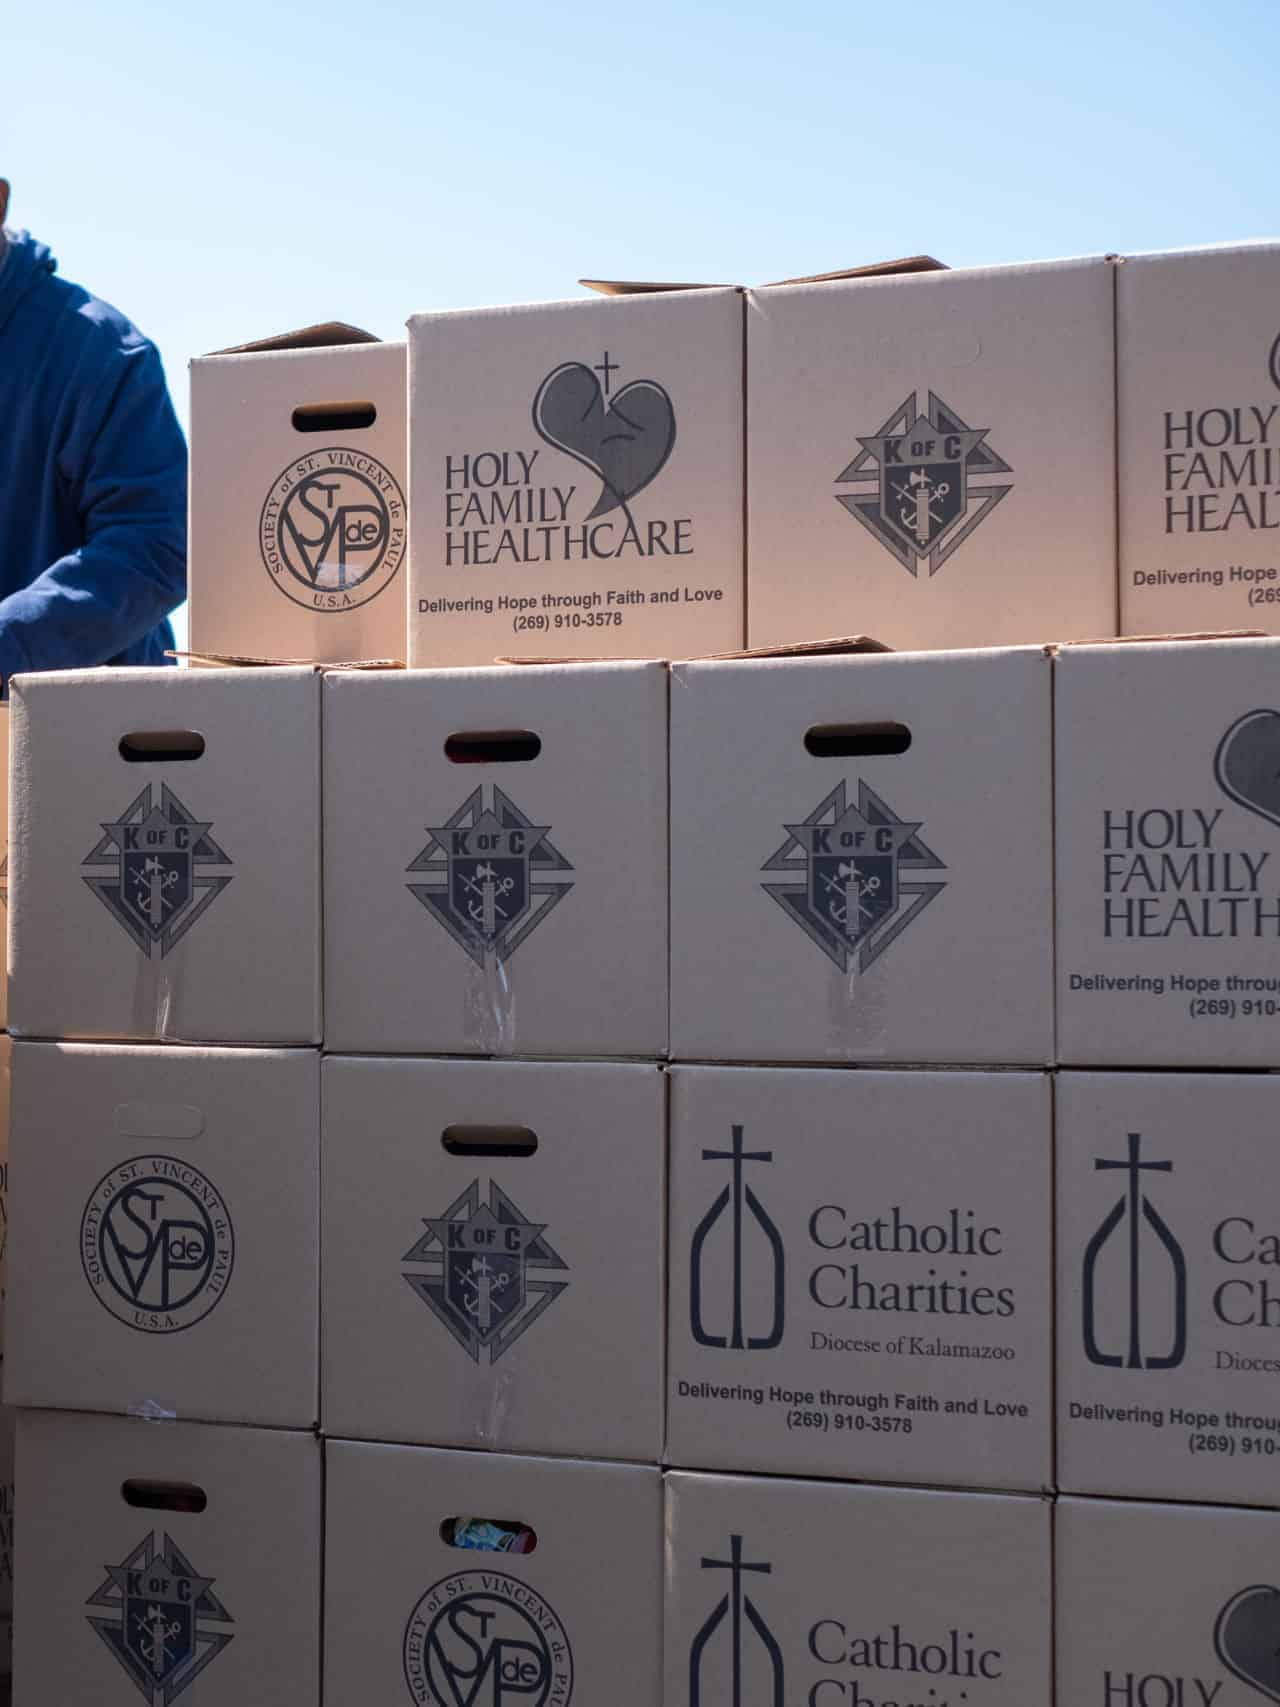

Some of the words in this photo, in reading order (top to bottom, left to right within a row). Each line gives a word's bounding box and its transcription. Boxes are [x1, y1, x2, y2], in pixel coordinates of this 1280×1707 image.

[1164, 405, 1279, 449] HOLY
[884, 439, 904, 464] K
[910, 440, 936, 457] OF
[944, 435, 962, 459] C
[297, 456, 320, 476] ST.
[327, 452, 395, 495] VINCENT
[446, 451, 539, 490] HOLY
[280, 475, 293, 494] of
[389, 500, 401, 520] de
[446, 486, 575, 527] FAMILY
[262, 499, 283, 575] SOCIETY
[381, 527, 404, 571] PAUL
[446, 519, 694, 565] HEALTHCARE
[1133, 568, 1224, 586] Delivering
[1230, 565, 1277, 586] Hope
[313, 592, 355, 607] U.S.A.
[419, 595, 493, 614] Delivering
[498, 593, 537, 612] Hope
[542, 590, 603, 610] through
[606, 588, 646, 604] Faith
[650, 587, 679, 602] and
[684, 586, 723, 602] Love
[512, 615, 550, 632] (269)
[554, 611, 623, 629] 910-3578
[123, 827, 137, 850] K
[147, 829, 168, 844] OF
[175, 827, 189, 849] C
[1104, 808, 1223, 849] HOLY
[452, 832, 472, 855] K
[477, 834, 500, 851] OF
[509, 831, 524, 855] C
[1104, 852, 1269, 892] FAMILY
[1070, 974, 1164, 994] Delivering
[1171, 974, 1220, 992] Hope
[1189, 1000, 1237, 1018] (269)
[118, 1161, 144, 1182] ST.
[152, 1159, 220, 1212] VINCENT
[102, 1180, 116, 1199] of
[214, 1218, 227, 1240] de
[448, 1223, 465, 1249] K
[473, 1228, 495, 1245] OF
[505, 1225, 521, 1251] C
[808, 1204, 1002, 1256] Catholic
[84, 1204, 104, 1285] SOCIETY
[206, 1248, 230, 1295] PAUL
[808, 1264, 1015, 1317] Charities
[134, 1311, 180, 1328] U.S.A.
[811, 1331, 881, 1354] Diocese
[886, 1335, 906, 1356] of
[908, 1337, 1016, 1361] Kalamazoo
[678, 1381, 764, 1404] Delivering
[769, 1385, 815, 1407] Hope
[819, 1387, 890, 1411] through
[894, 1392, 937, 1414] Faith
[942, 1397, 977, 1414] and
[983, 1398, 1029, 1418] Love
[786, 1409, 829, 1432] (269)
[833, 1410, 913, 1434] 910-3578
[1069, 1403, 1165, 1427] Delivering
[1170, 1408, 1220, 1430] Hope
[1188, 1433, 1235, 1456] (269)
[808, 1619, 1002, 1678] Catholic
